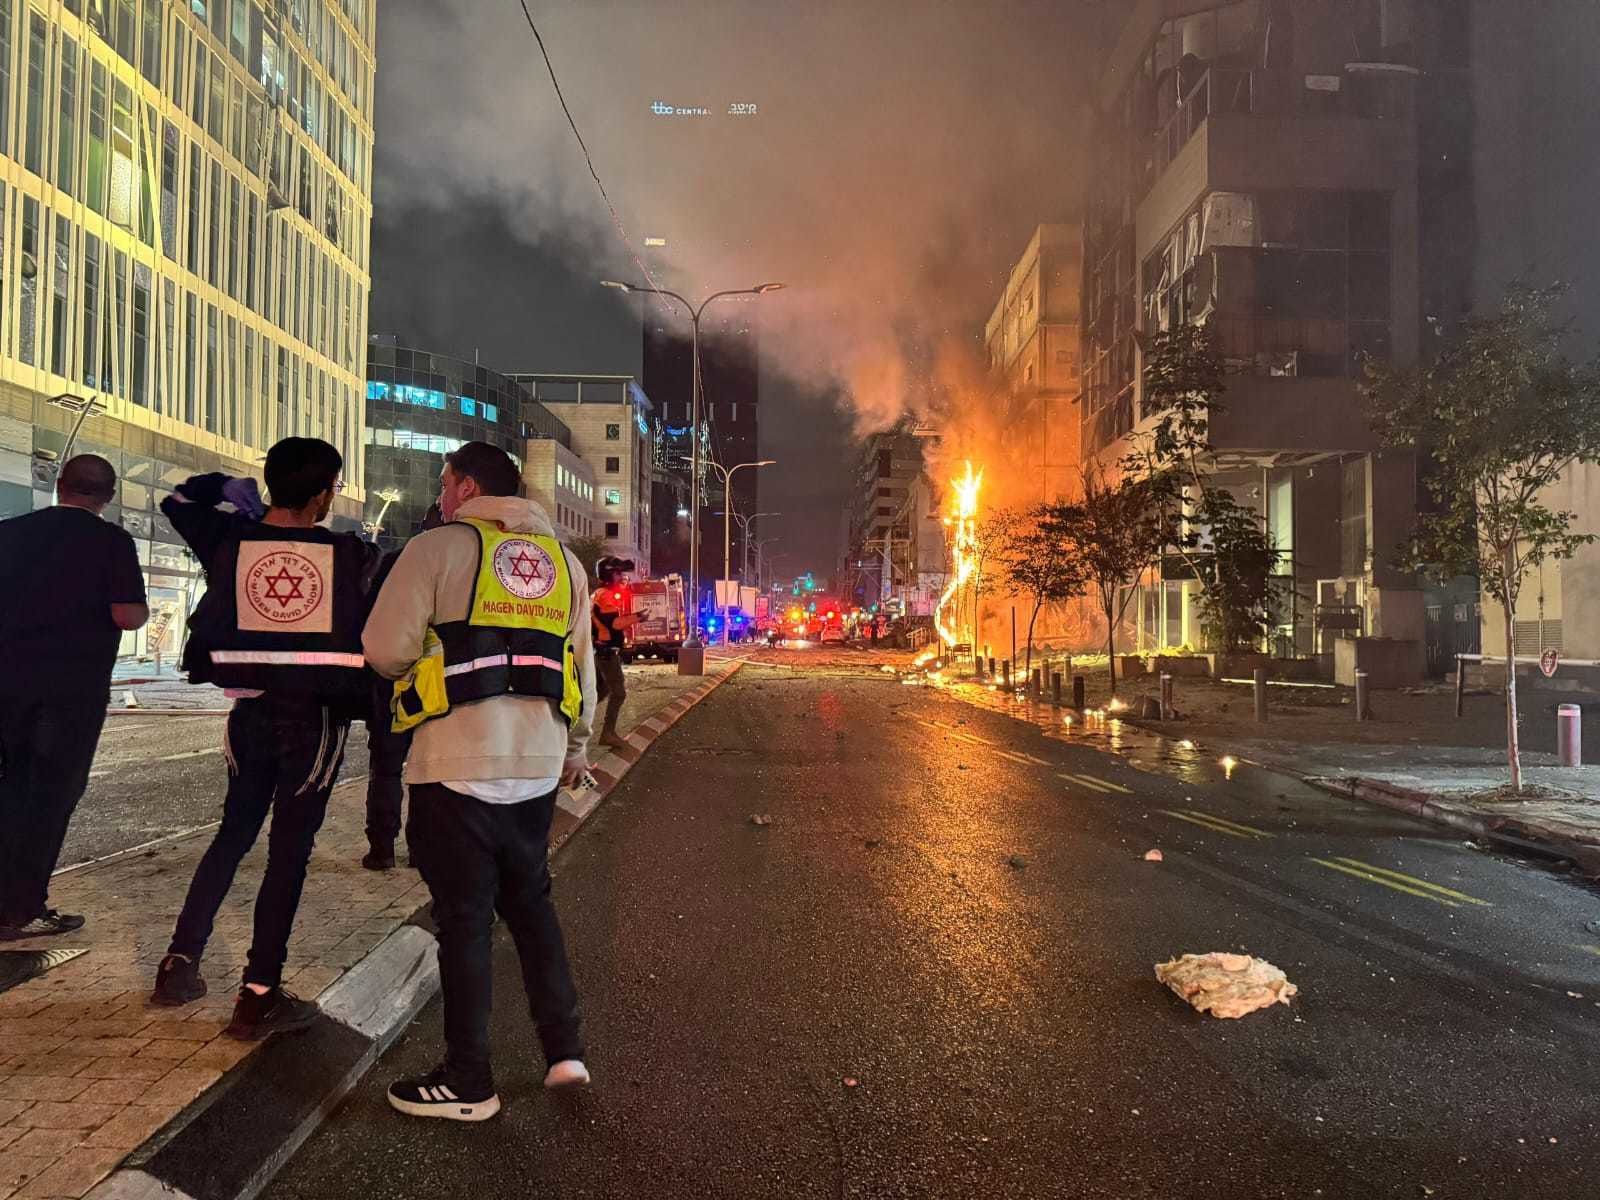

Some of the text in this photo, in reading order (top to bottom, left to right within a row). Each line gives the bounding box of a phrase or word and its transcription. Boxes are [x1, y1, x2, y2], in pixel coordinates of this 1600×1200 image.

[676, 107, 712, 115] CENTRAL
[254, 557, 316, 579] מגן דוד אדום
[251, 583, 318, 619] MAGEN DAVID ADOM
[483, 600, 514, 614] MAGEN
[516, 602, 545, 618] DAVID
